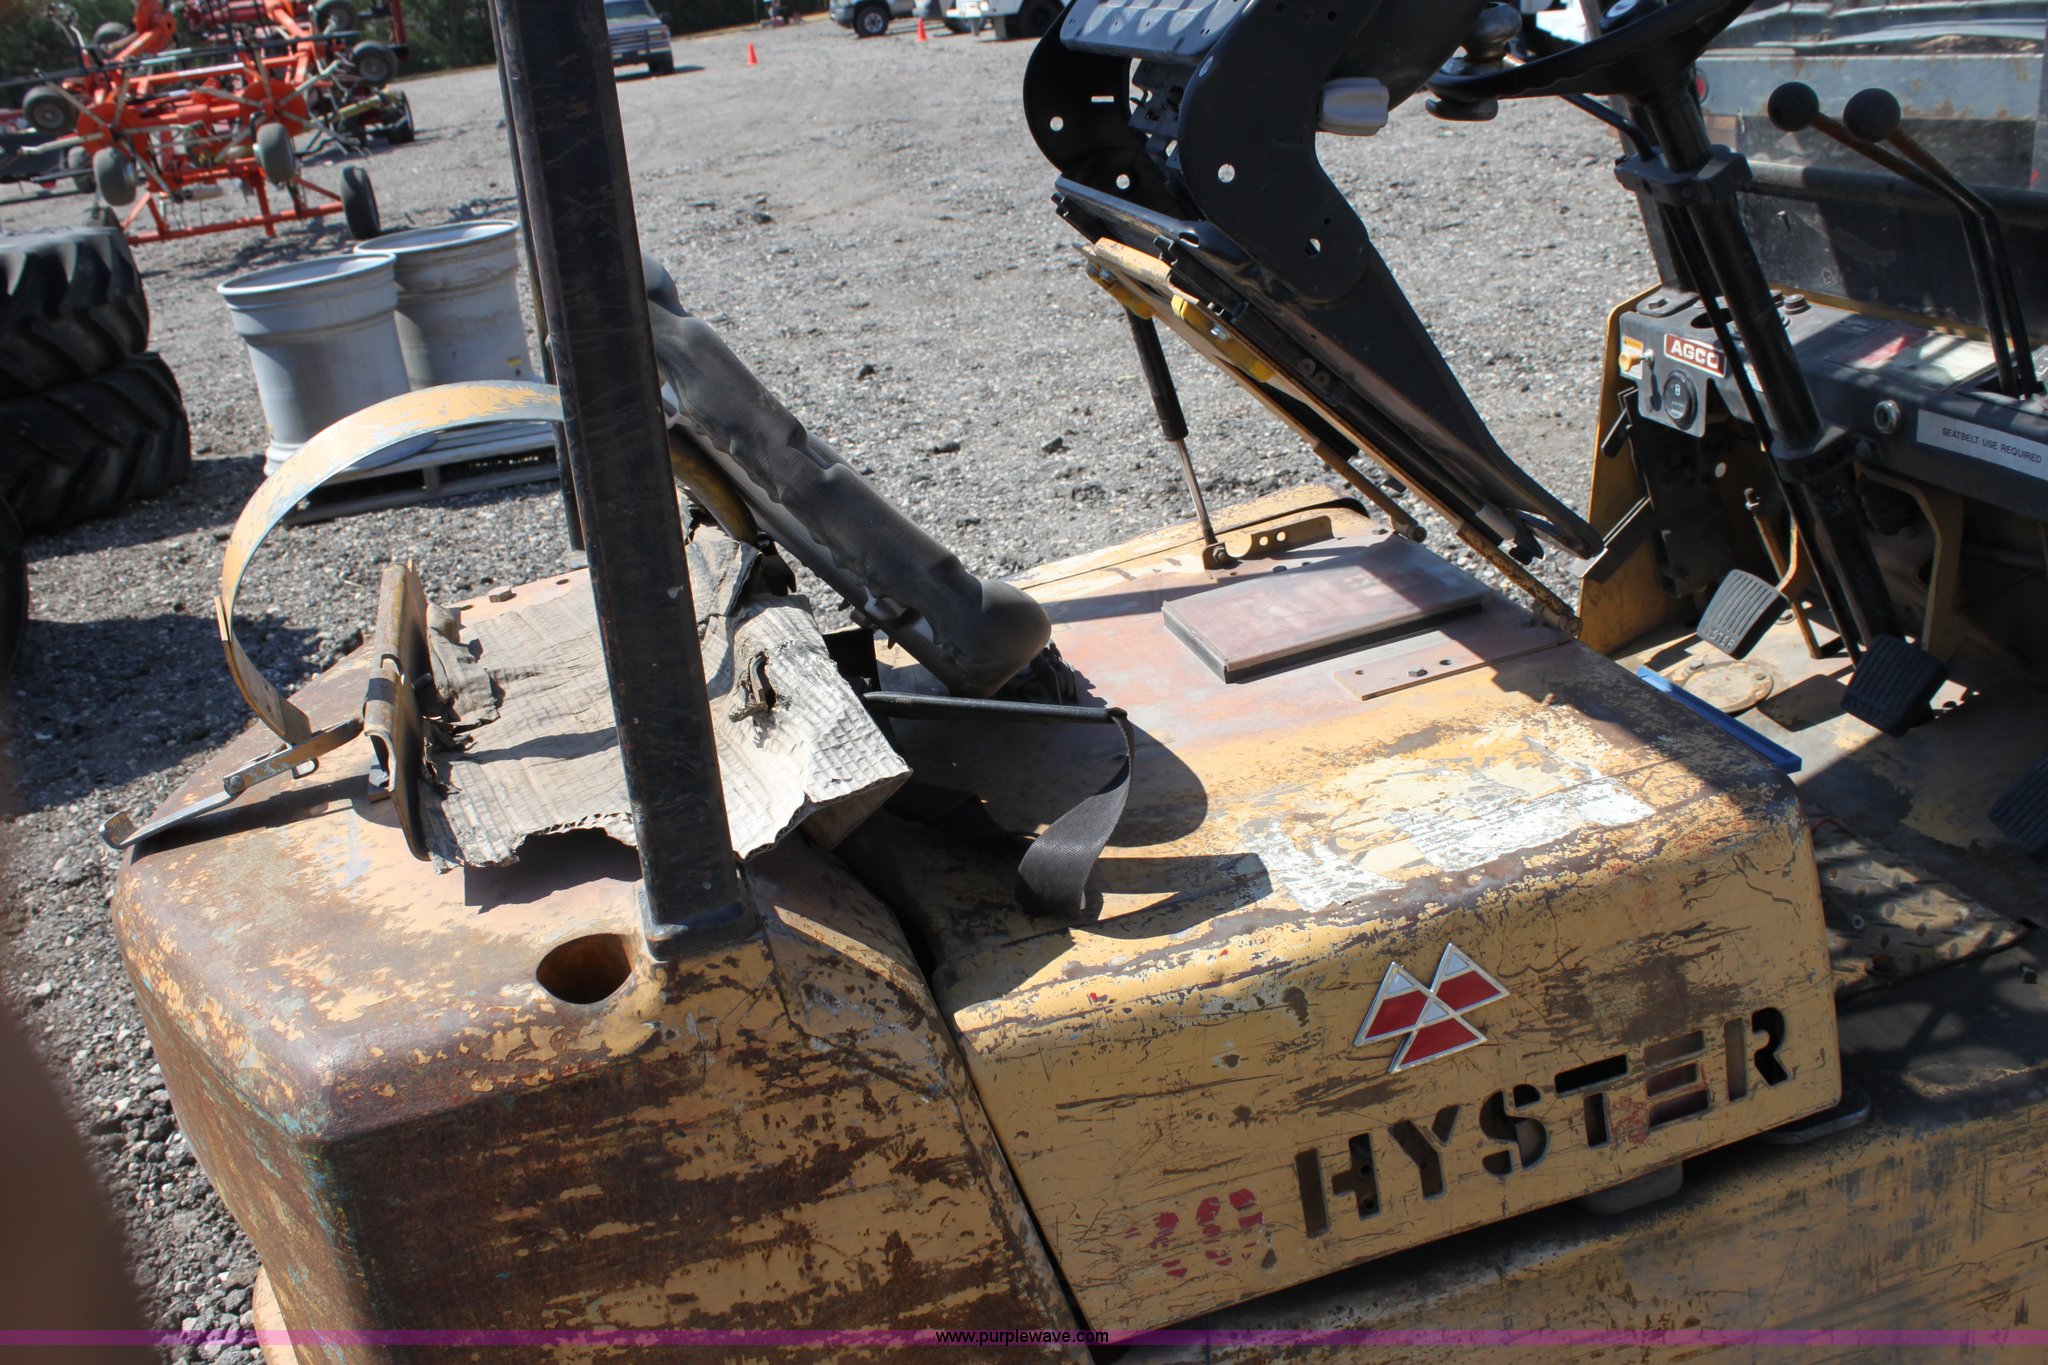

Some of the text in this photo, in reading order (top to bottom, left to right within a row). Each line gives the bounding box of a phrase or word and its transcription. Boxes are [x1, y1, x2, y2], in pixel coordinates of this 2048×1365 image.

[1670, 339, 1720, 370] AGCO
[1942, 427, 2043, 464] SEATBELT USE REQUIRED
[1295, 1006, 1790, 1239] HYSTER
